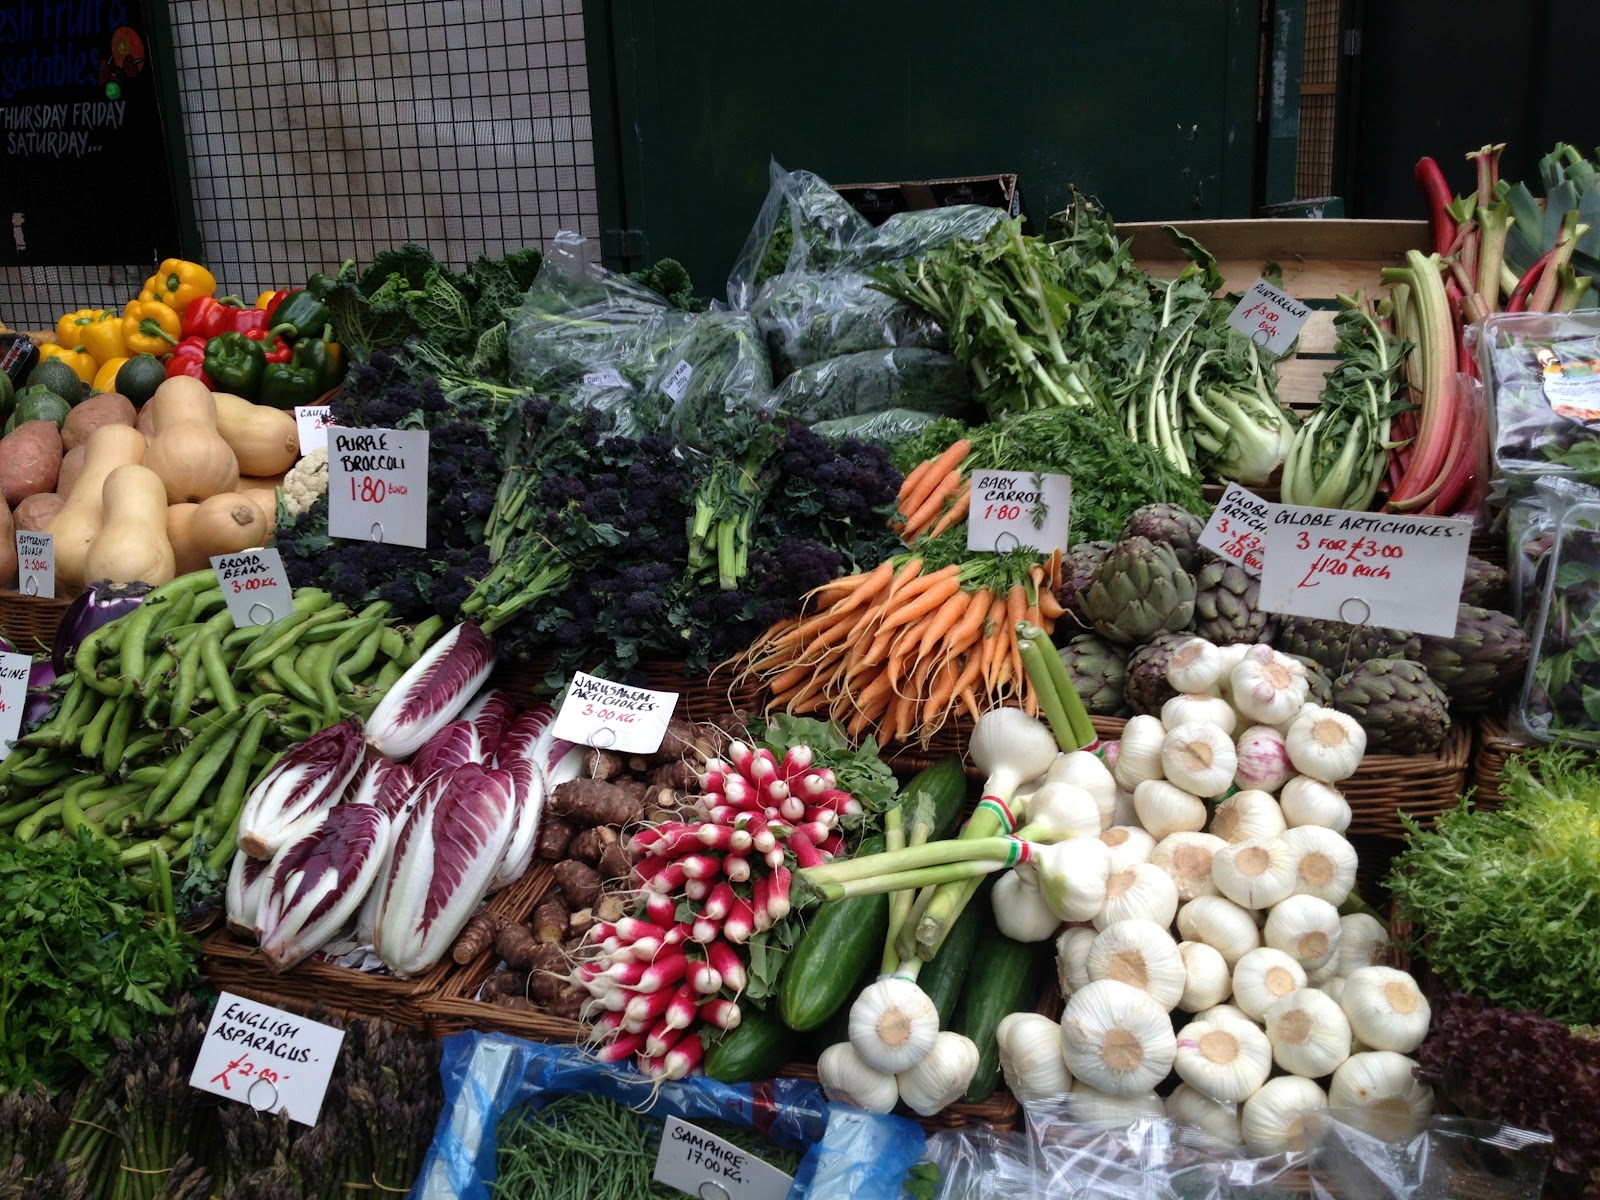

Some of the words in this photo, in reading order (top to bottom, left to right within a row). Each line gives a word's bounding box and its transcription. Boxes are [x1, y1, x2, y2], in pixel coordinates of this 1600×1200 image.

[73, 100, 126, 129] FRIDAY
[335, 433, 390, 452] PURPLE
[341, 455, 406, 472] BROCCOLI
[978, 476, 1017, 490] BABY
[1226, 490, 1269, 519] GLOBE
[1216, 518, 1230, 533] 3
[1274, 510, 1337, 527] GLOBE
[1296, 531, 1311, 550] 3
[1317, 538, 1348, 552] FOR
[219, 555, 260, 570] BROAD
[1352, 564, 1391, 580] each
[0, 667, 28, 680] GINE
[222, 1003, 300, 1039] ENGLISH
